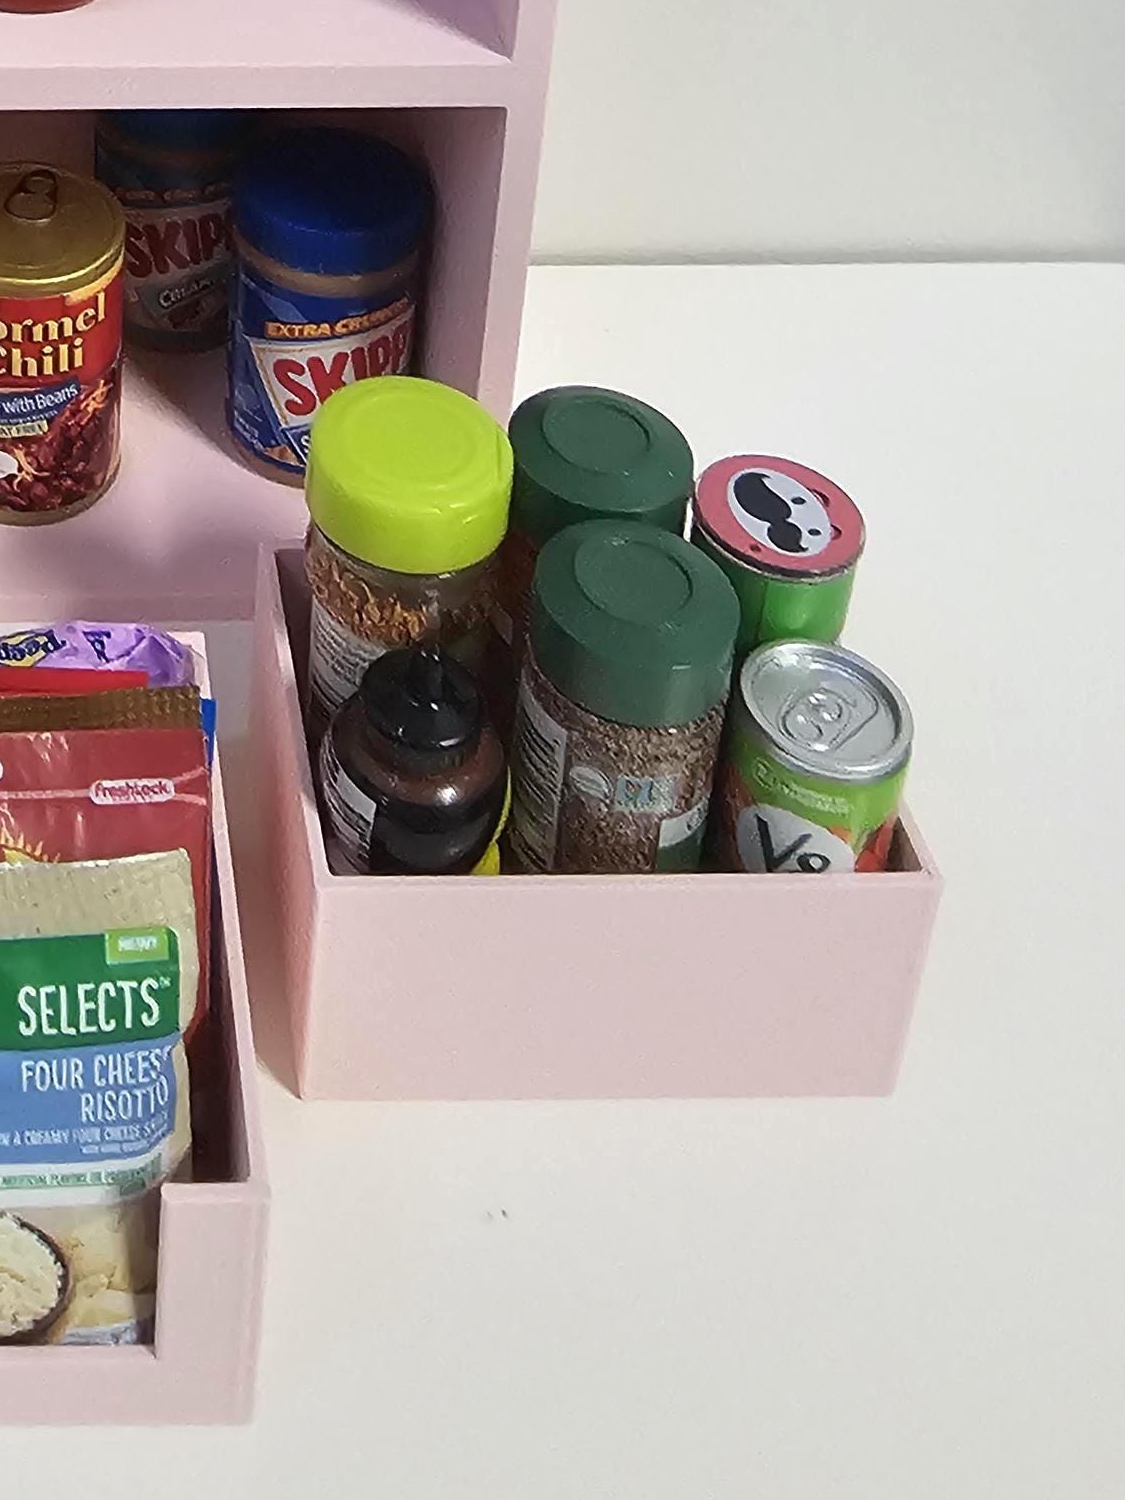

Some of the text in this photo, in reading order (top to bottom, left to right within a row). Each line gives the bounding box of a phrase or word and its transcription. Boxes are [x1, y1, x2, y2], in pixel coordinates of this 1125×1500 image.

[125, 212, 223, 278] SKIP
[266, 320, 332, 338] EXTRA
[2, 396, 35, 414] with
[35, 384, 79, 410] Beans
[18, 976, 161, 1036] SELECTS
[21, 1057, 84, 1092] FOUR
[80, 1074, 170, 1123] RISOTTO
